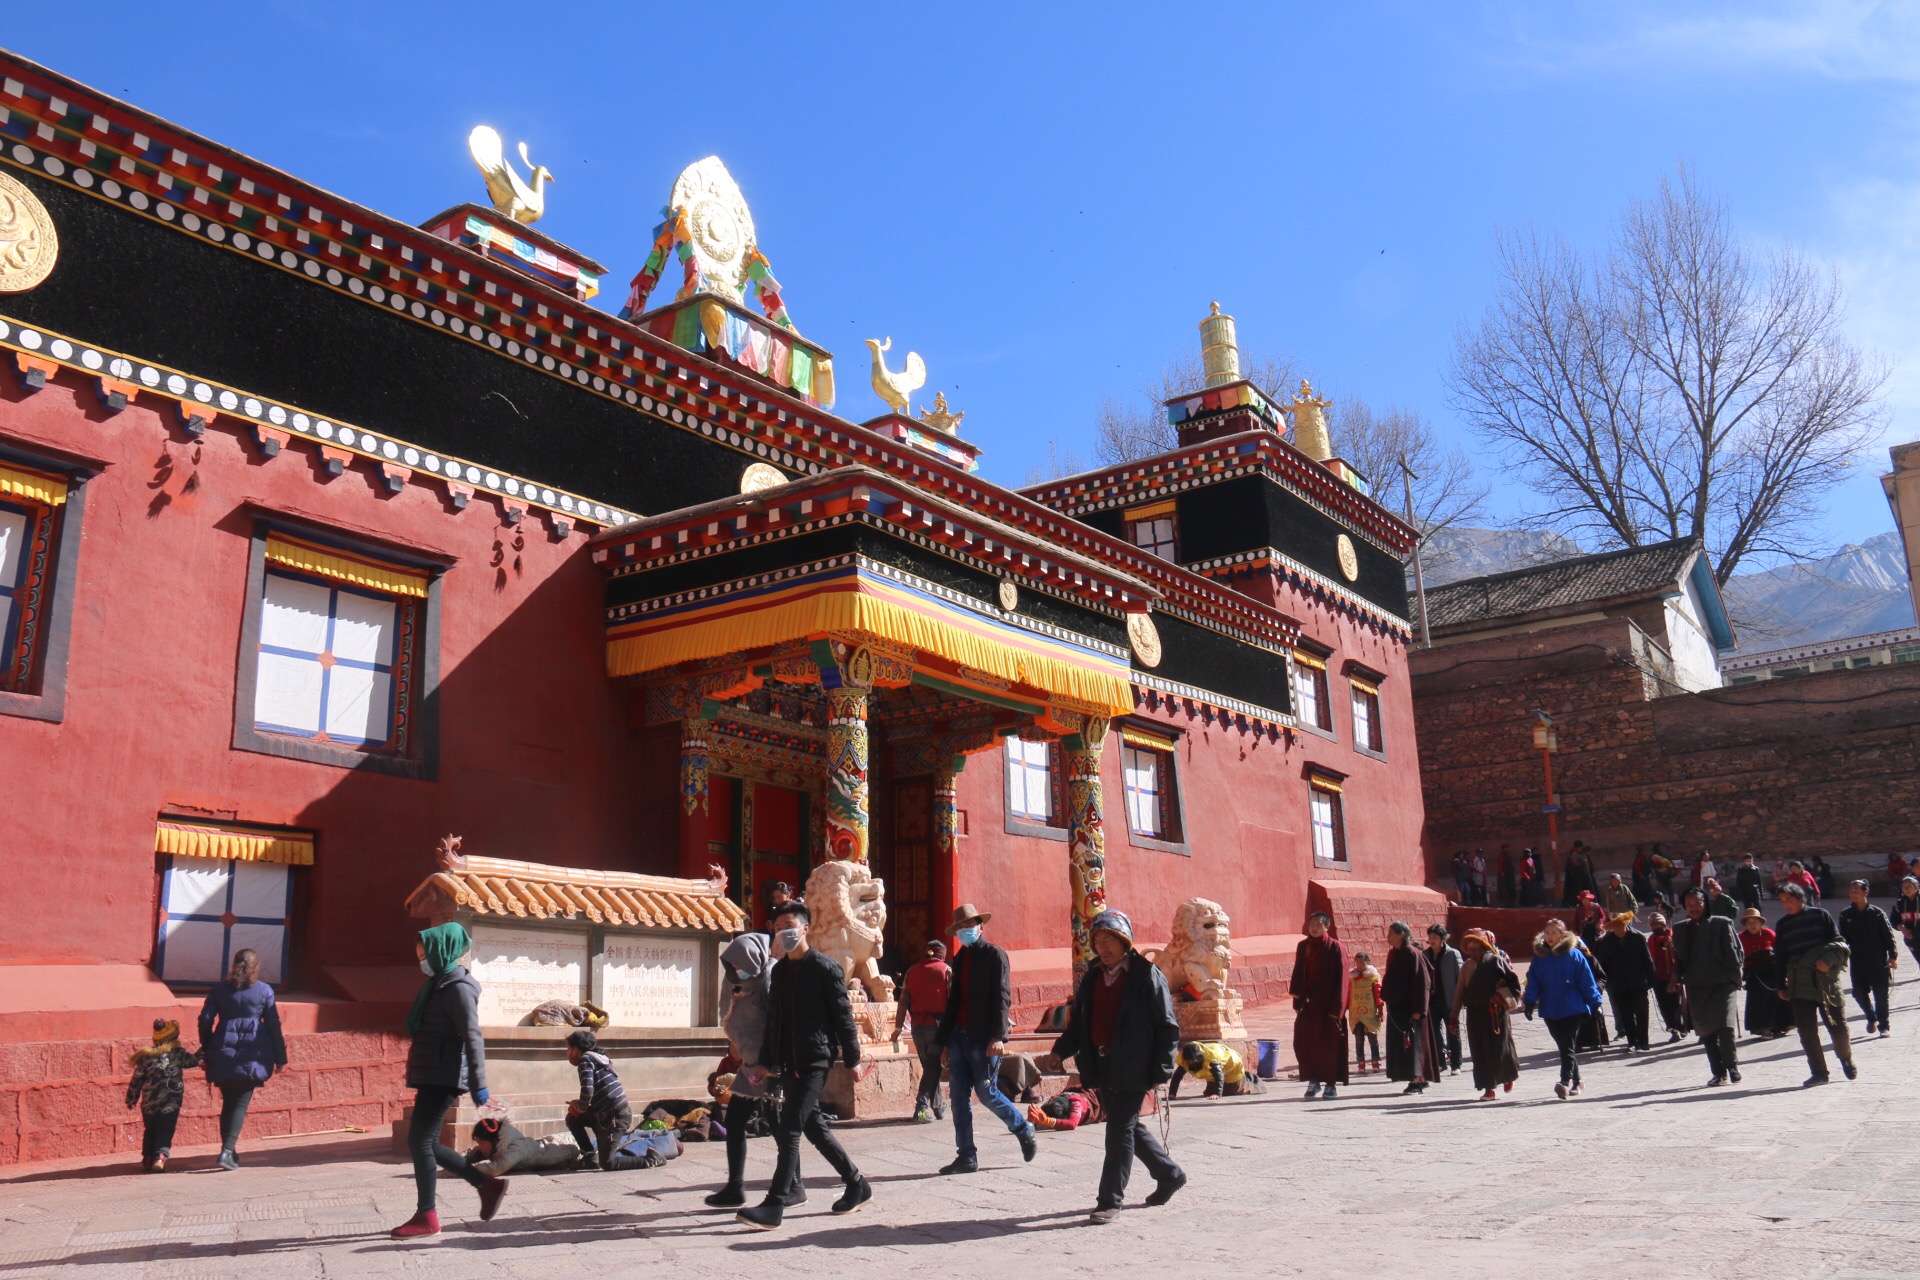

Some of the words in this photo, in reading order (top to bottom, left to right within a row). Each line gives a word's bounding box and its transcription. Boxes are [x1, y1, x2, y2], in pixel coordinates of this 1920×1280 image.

[607, 945, 694, 961] 全国重点文物保护单位
[610, 984, 688, 998] 中华人民共和国国务院
